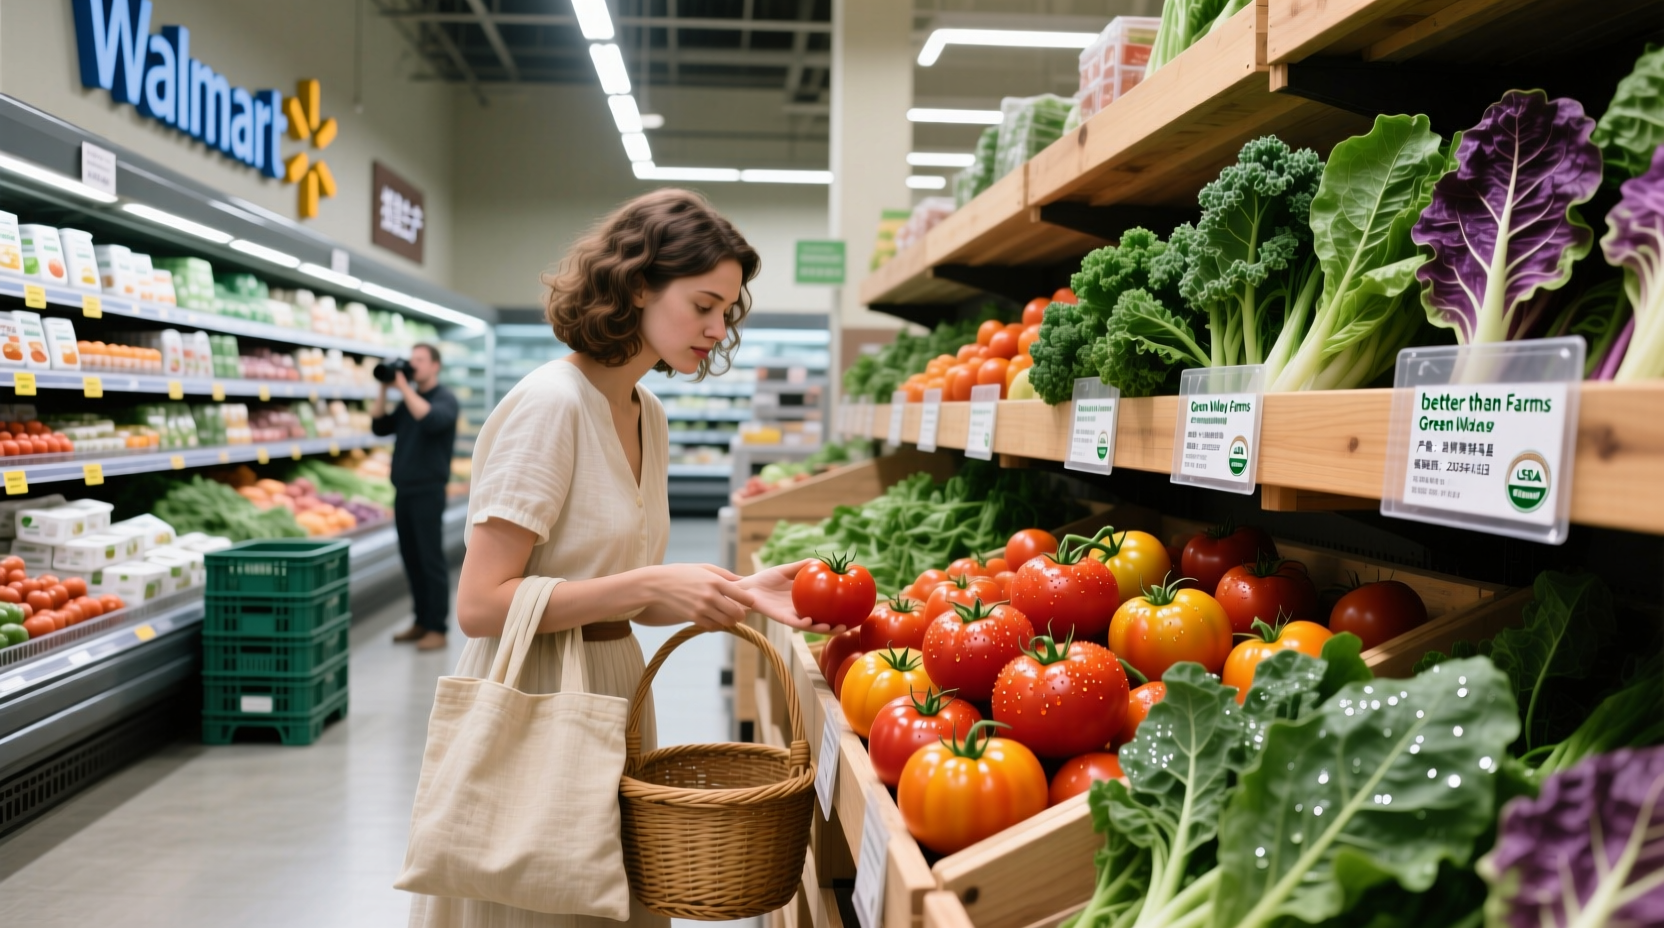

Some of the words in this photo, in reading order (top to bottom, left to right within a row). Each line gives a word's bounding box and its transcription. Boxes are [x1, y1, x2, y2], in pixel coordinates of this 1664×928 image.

[73, 0, 289, 180] Walmart
[1421, 392, 1466, 411] better
[1469, 392, 1501, 412] than
[1506, 393, 1552, 413] Farms
[1419, 415, 1454, 432] Green
